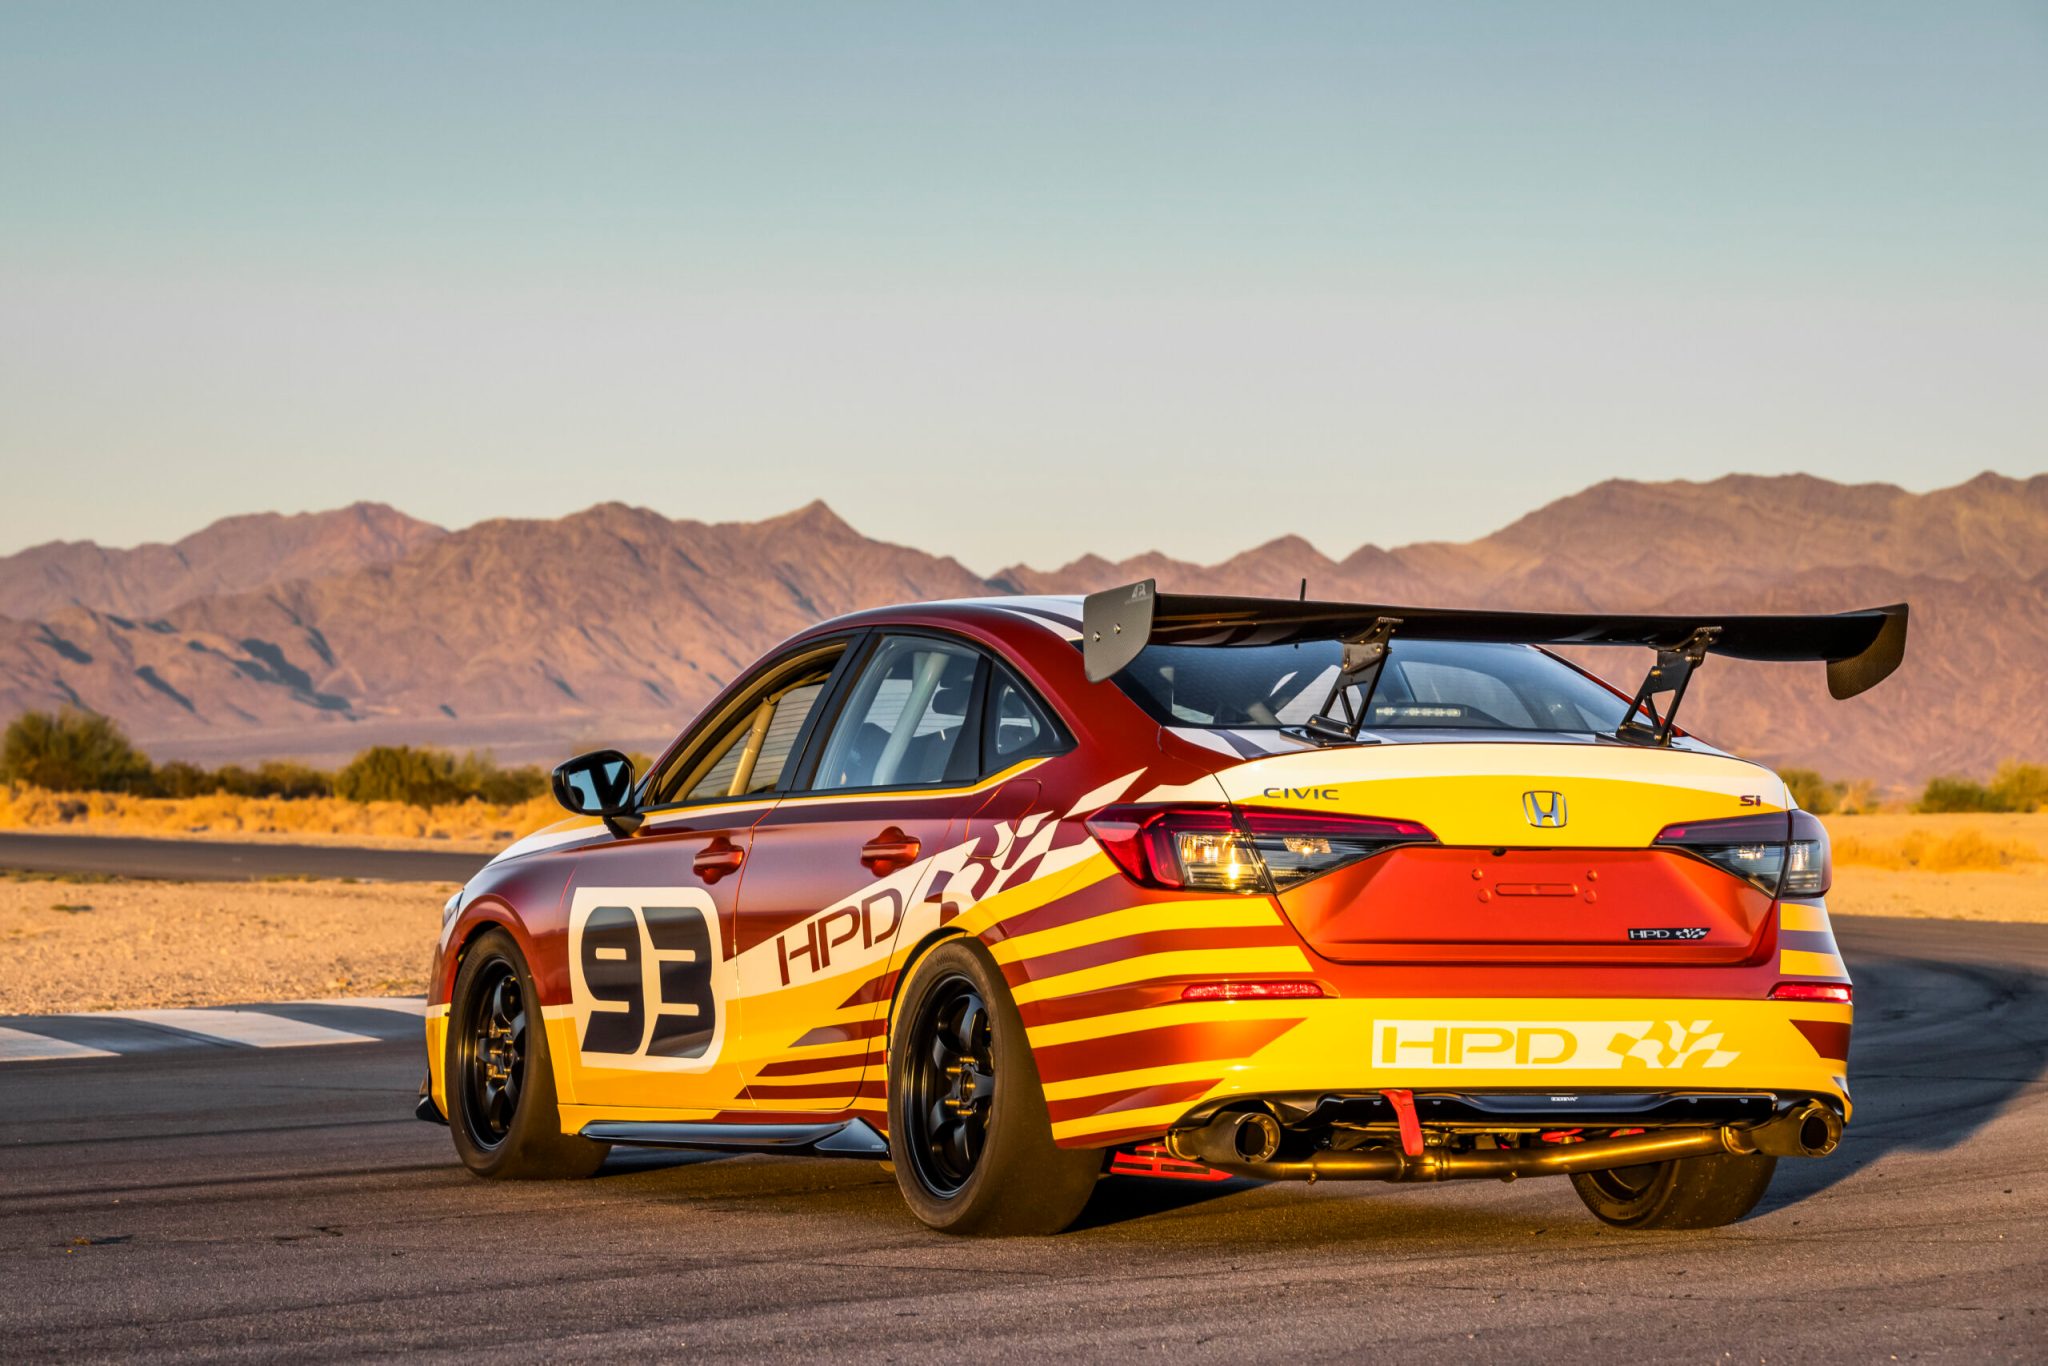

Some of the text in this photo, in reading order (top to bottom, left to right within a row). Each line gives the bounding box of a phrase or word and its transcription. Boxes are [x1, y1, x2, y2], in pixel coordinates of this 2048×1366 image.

[1263, 787, 1340, 800] CIVIC
[776, 888, 903, 987] HPD
[1629, 929, 1670, 939] HPD
[581, 906, 716, 1059] 93
[1381, 1026, 1578, 1065] HPD
